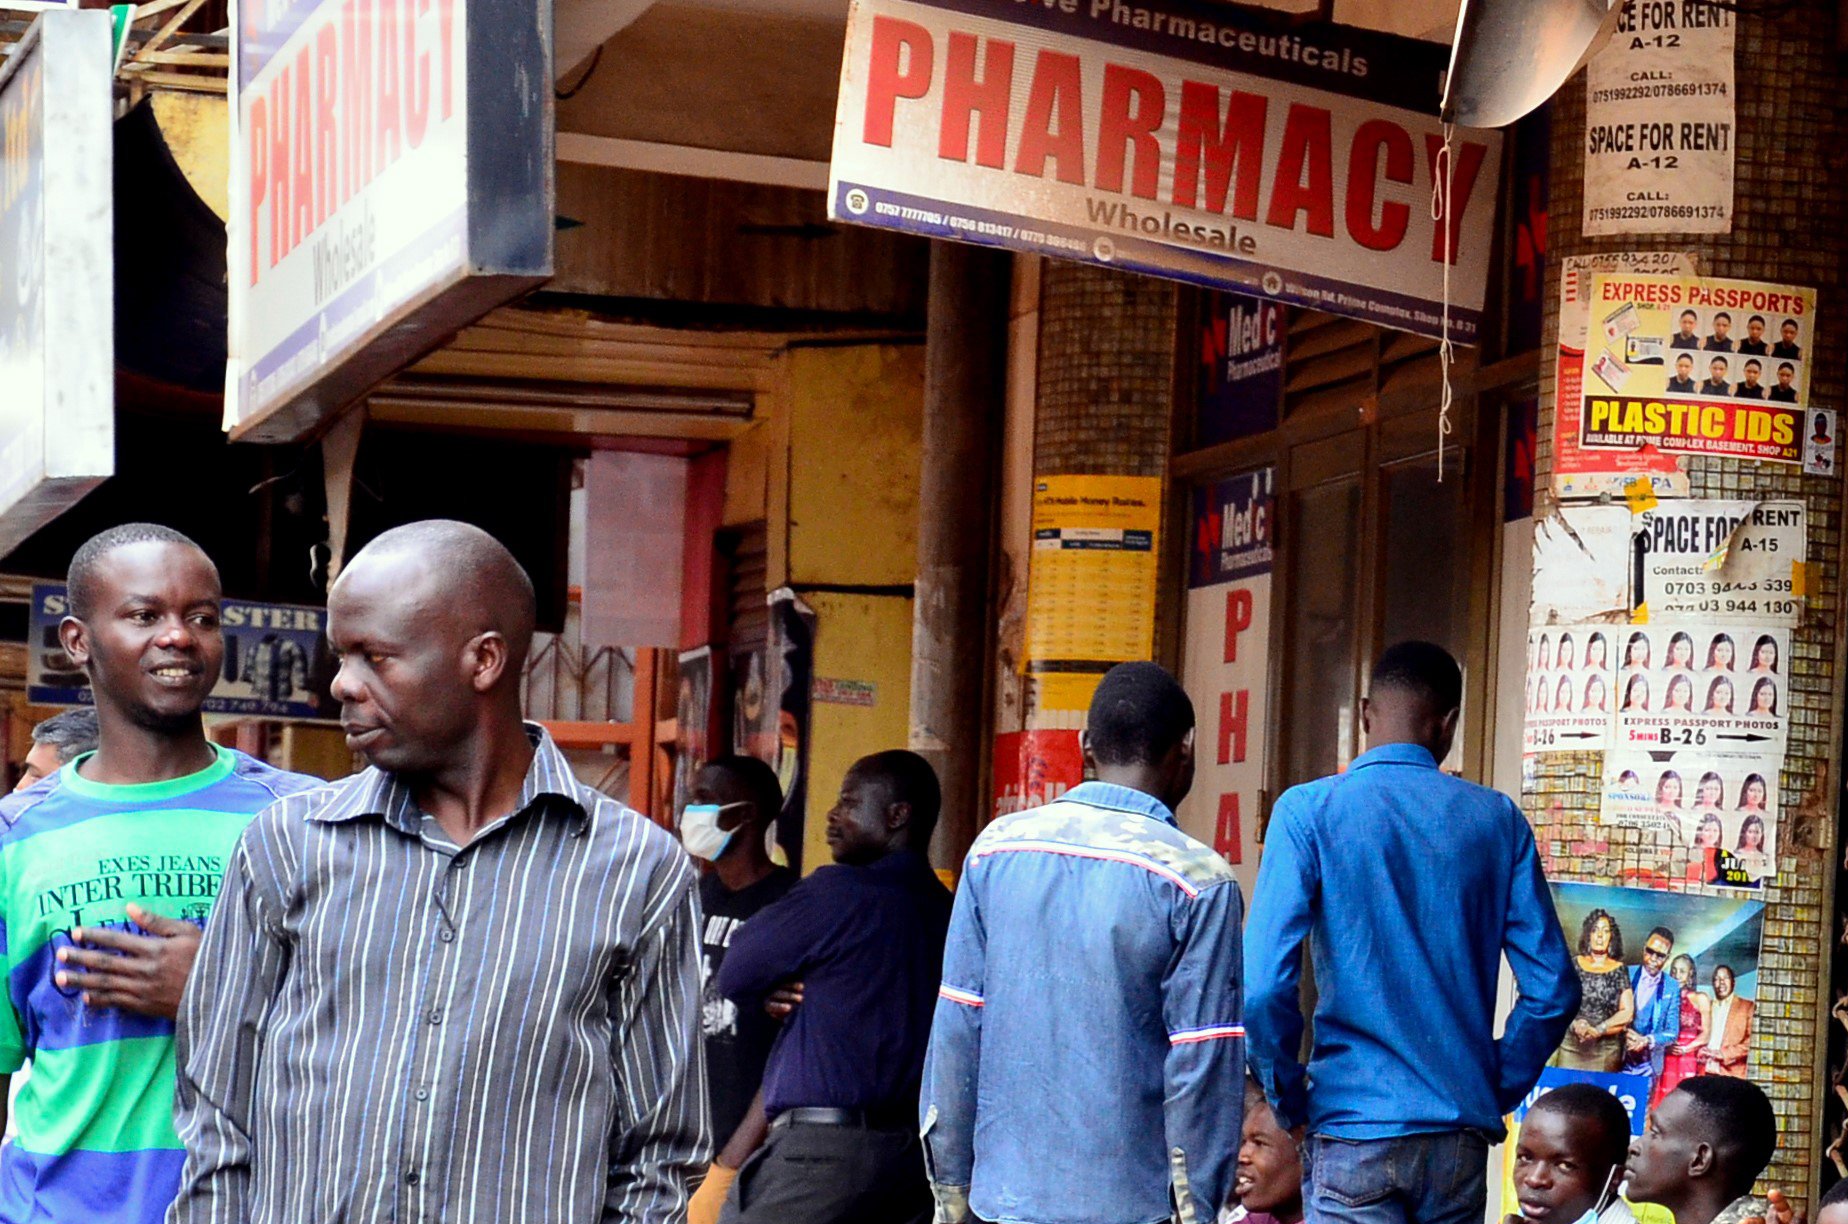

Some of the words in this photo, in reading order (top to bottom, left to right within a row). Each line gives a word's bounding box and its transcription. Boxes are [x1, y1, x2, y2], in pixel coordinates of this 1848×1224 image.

[1642, 1, 1675, 30] FOR
[1629, 34, 1680, 50] A-12
[1630, 71, 1673, 82] CALL:
[862, 14, 1488, 267] PHARMACY
[1589, 124, 1635, 154] SPACE
[1639, 123, 1674, 151] FOR
[1680, 123, 1731, 151] RENT
[1627, 156, 1679, 170] A-12
[1626, 191, 1669, 202] CALL:
[1086, 197, 1257, 255] Wholesale
[312, 199, 376, 306] Wholesale
[1602, 282, 1682, 304] EXPRESS
[1688, 286, 1804, 316] PASSPORTS
[1590, 400, 1726, 438] PLASTIC
[1734, 409, 1795, 445] IDS
[1663, 436, 1705, 449] COMPLEX
[1757, 444, 1781, 457] SHOP
[1753, 510, 1800, 527] RENT
[1741, 538, 1779, 552] A-15
[1653, 565, 1704, 576] Contact:
[1664, 582, 1706, 595] 0703
[1726, 600, 1758, 613] 944
[1764, 601, 1793, 614] 130
[221, 604, 320, 631] STER
[1572, 717, 1608, 727] PHOTOS
[1624, 717, 1670, 727] EXPRESS
[1674, 718, 1732, 729] PASSPORT
[1735, 720, 1780, 731] PHOTOS
[1660, 727, 1707, 746] B-26
[98, 856, 150, 876] EXES
[156, 855, 221, 872] JEANS
[38, 874, 124, 918] INTER
